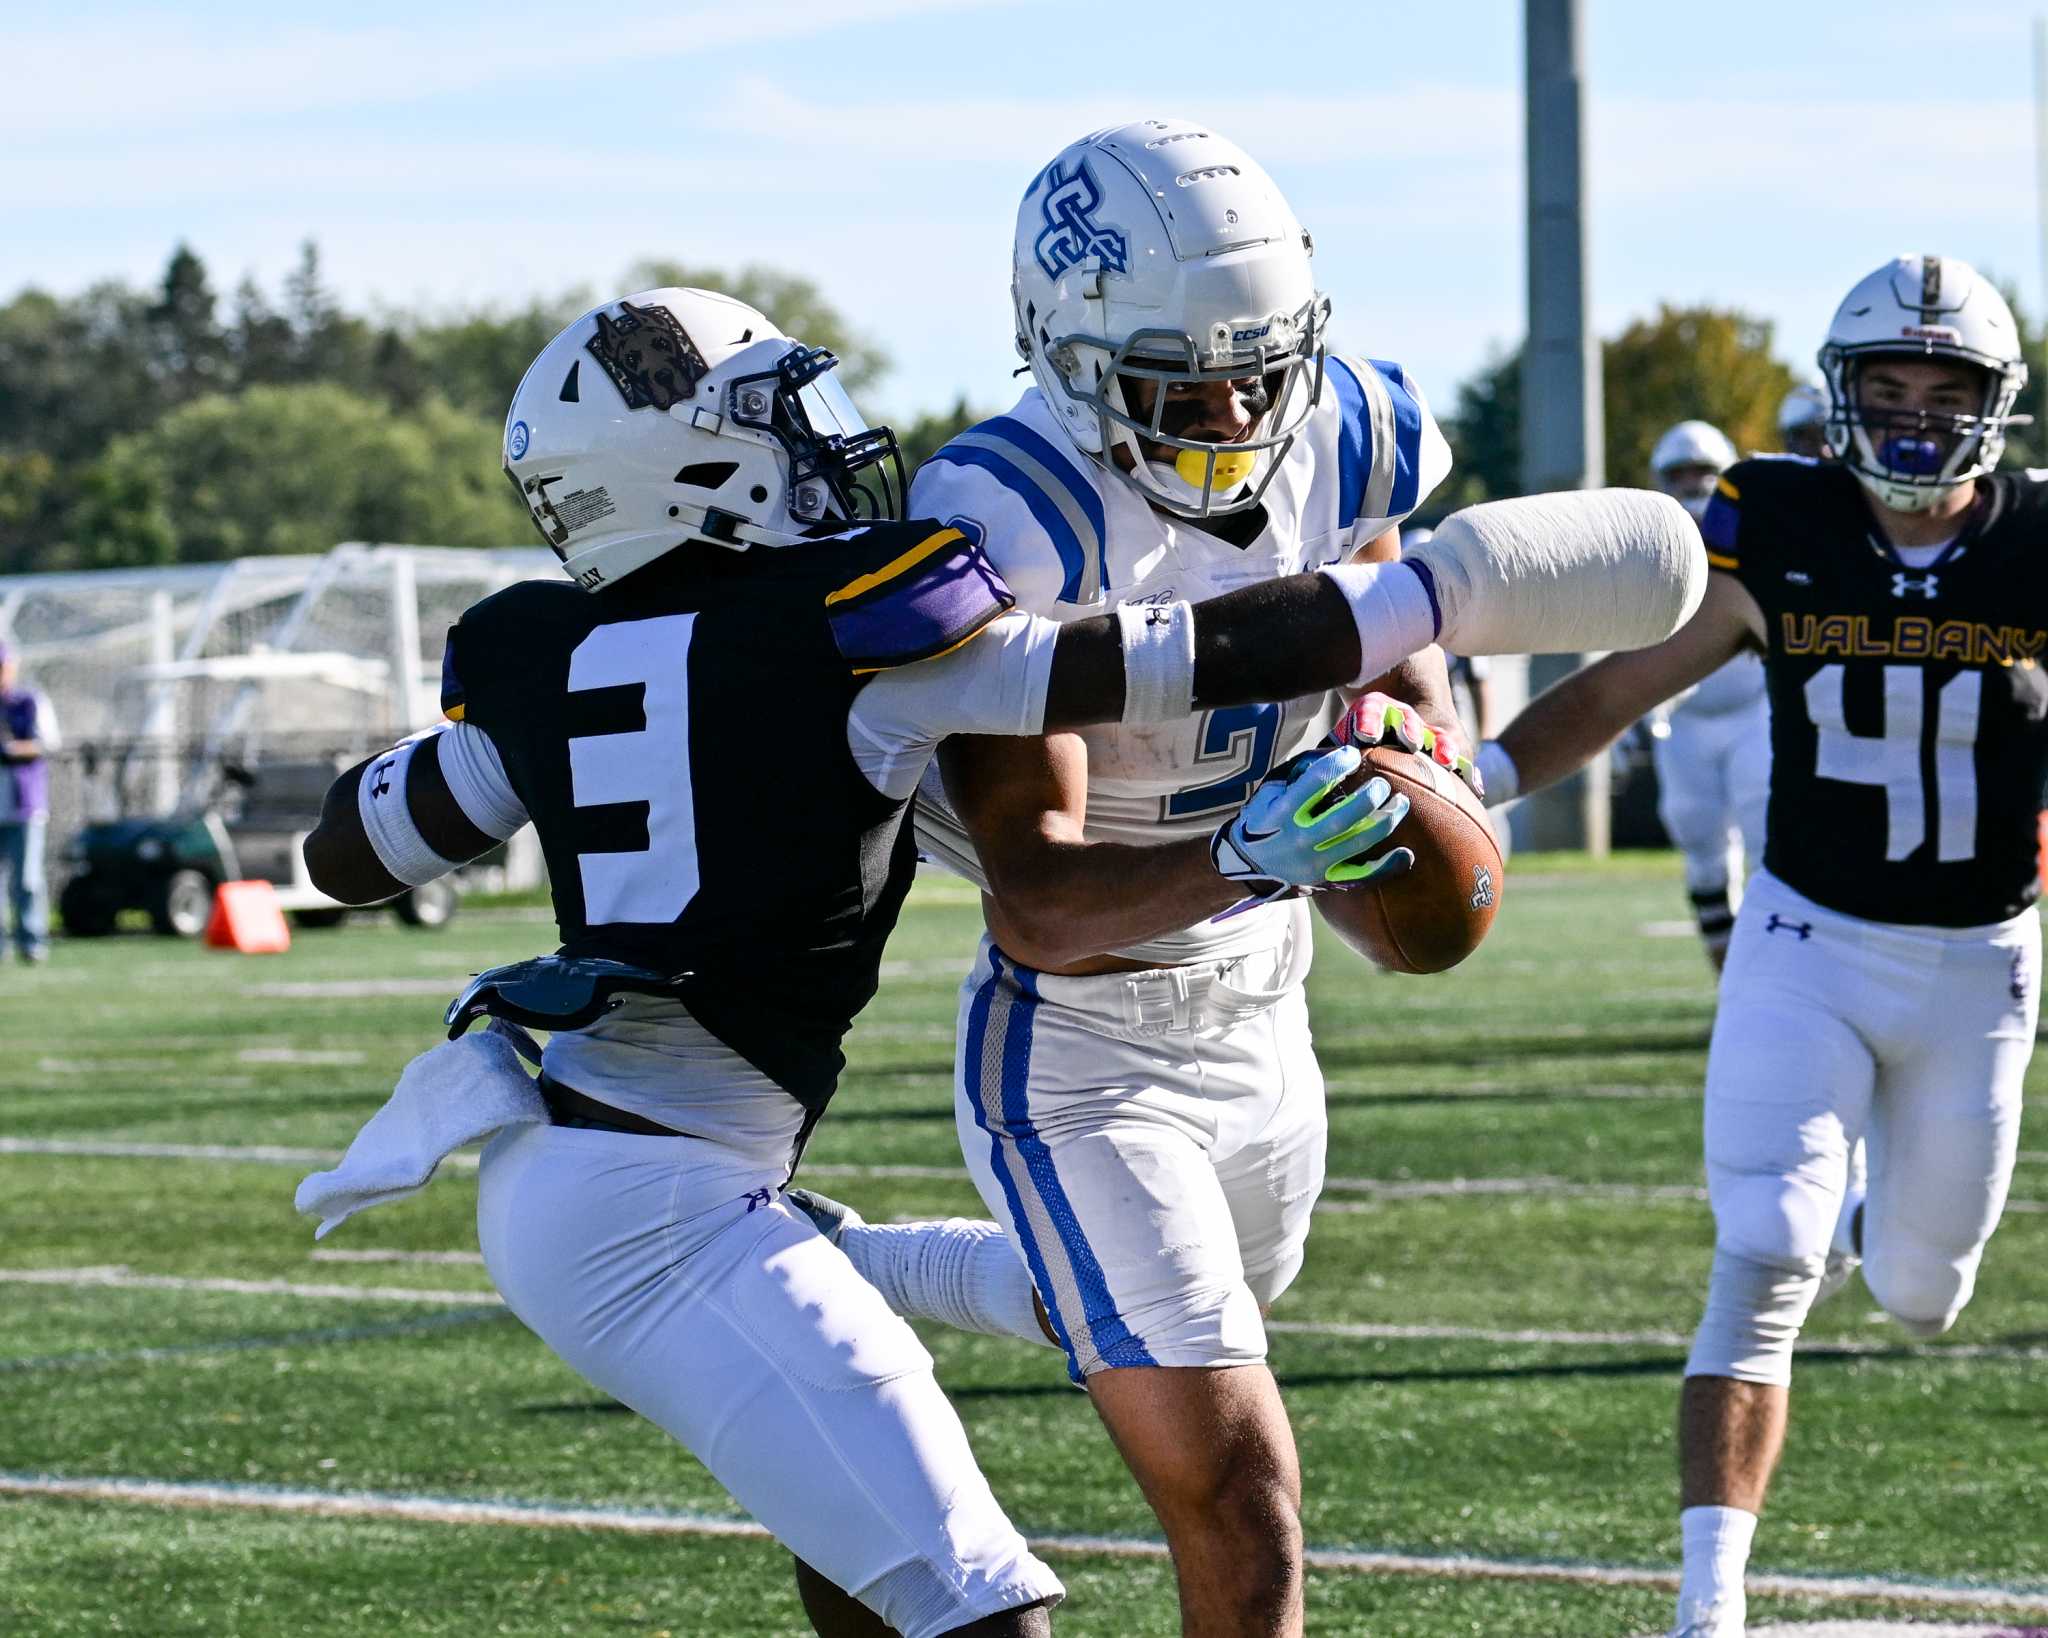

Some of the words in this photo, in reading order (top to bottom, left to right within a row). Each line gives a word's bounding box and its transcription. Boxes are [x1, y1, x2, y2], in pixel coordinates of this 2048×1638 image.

[1232, 325, 1271, 342] CCSU
[1782, 612, 2047, 667] UALBANY
[568, 611, 700, 926] 3
[1157, 701, 1285, 825] 2
[1804, 663, 1982, 863] 41
